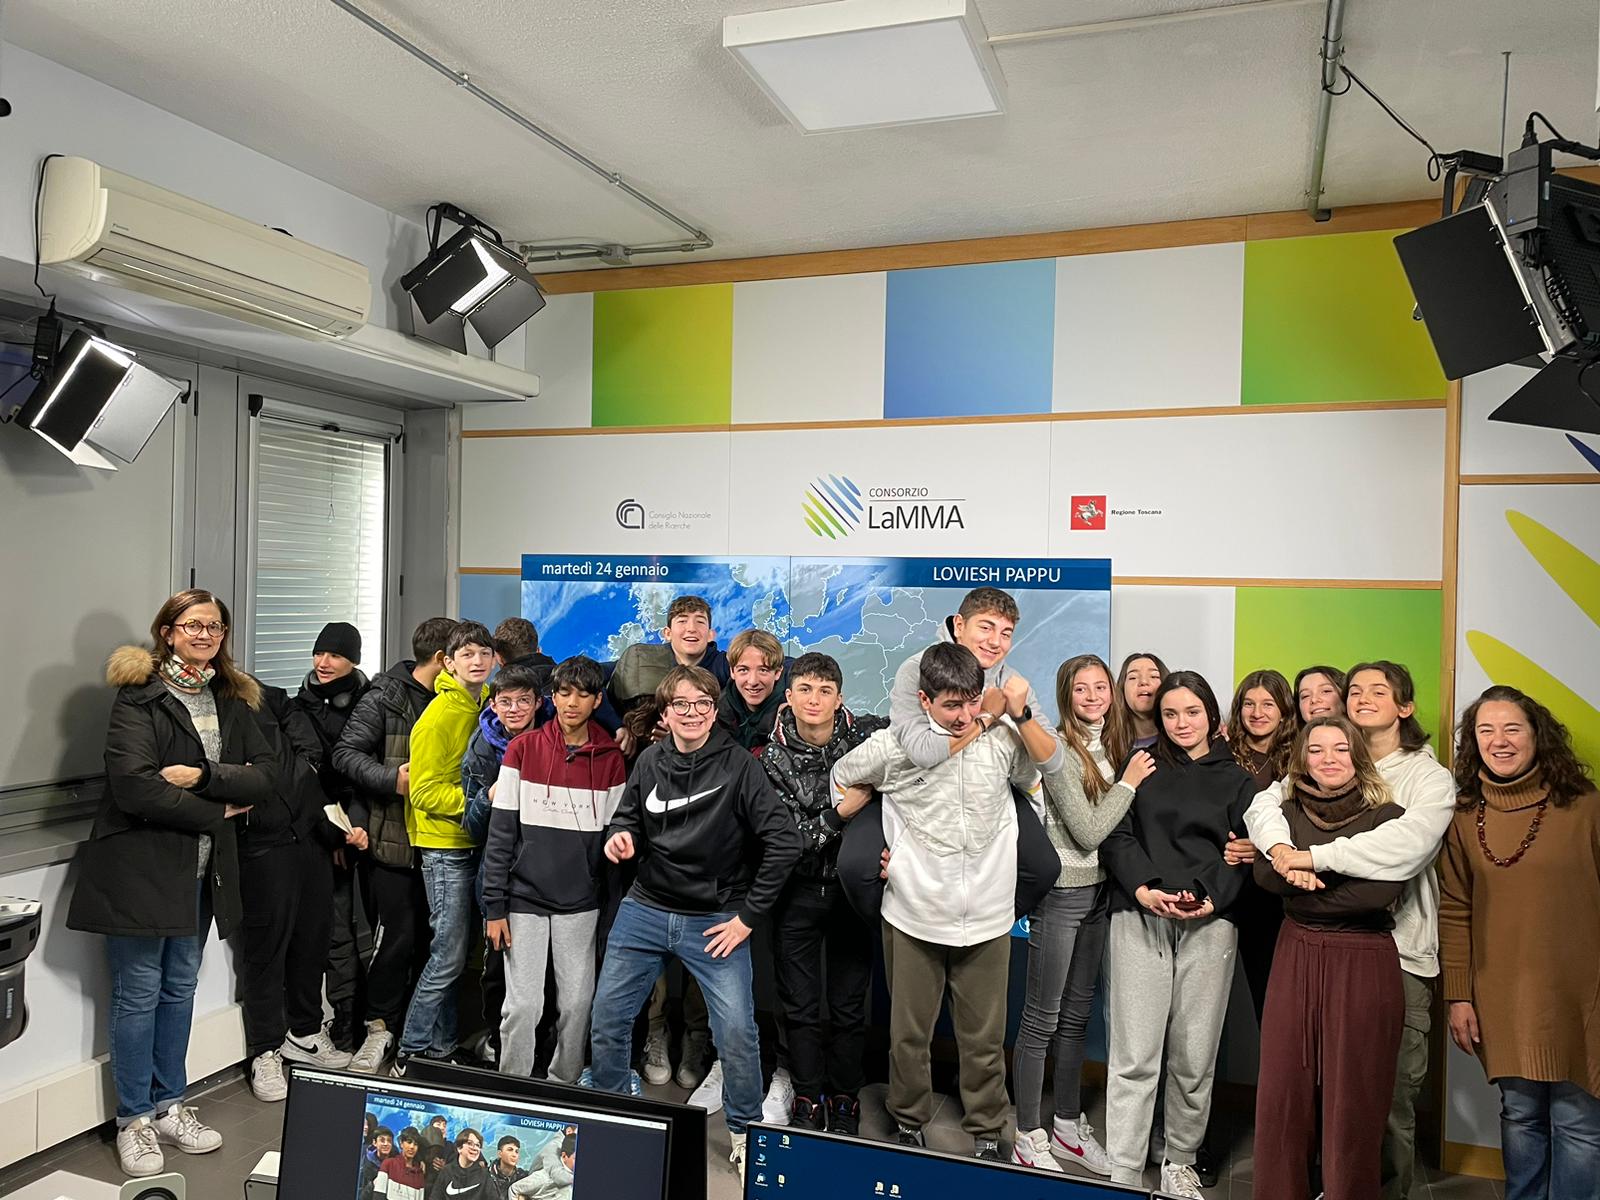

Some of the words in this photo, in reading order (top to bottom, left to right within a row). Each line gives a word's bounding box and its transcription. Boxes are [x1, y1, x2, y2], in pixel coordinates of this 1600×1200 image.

[869, 487, 929, 498] CONSORZIO
[648, 510, 677, 521] Consiglio
[678, 511, 712, 520] Nazionale
[868, 505, 965, 530] LaMMA
[1111, 509, 1136, 517] Regione
[648, 521, 664, 530] delle
[541, 561, 592, 576] martedì
[595, 562, 612, 575] 24
[615, 562, 669, 579] gennaio
[932, 566, 1000, 582] LOVIESH
[1005, 567, 1061, 583] PAPPU
[395, 1099, 403, 1107] 24
[403, 1101, 426, 1110] gennaio
[520, 1118, 545, 1128] LOVIESH
[545, 1121, 566, 1131] PAPPU
